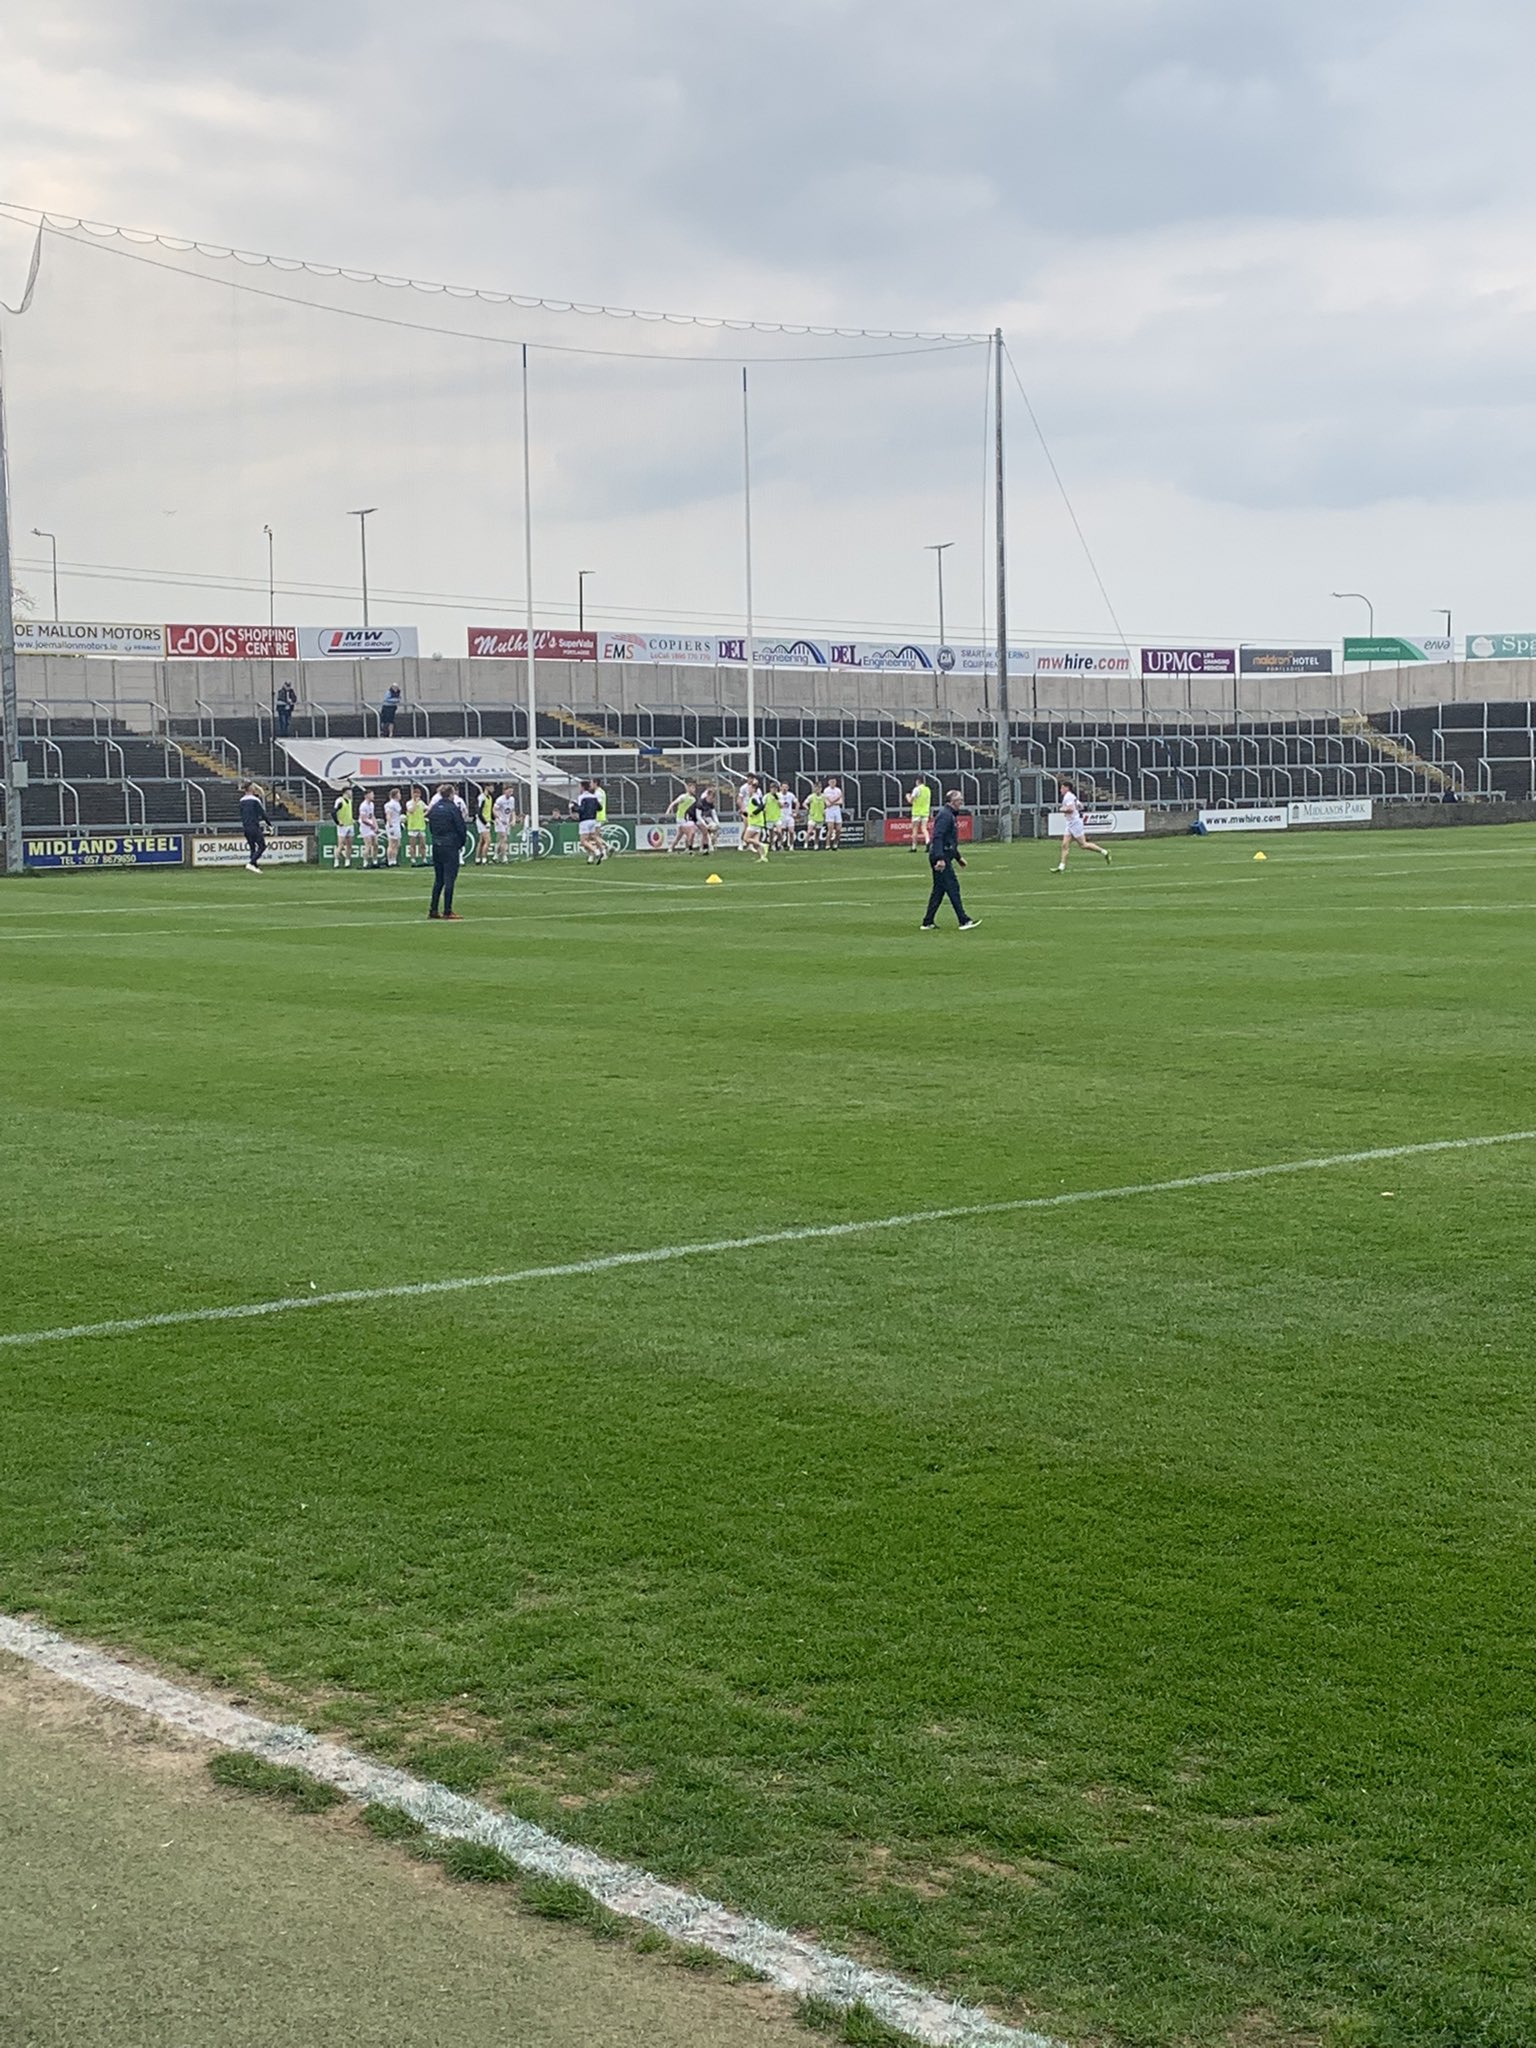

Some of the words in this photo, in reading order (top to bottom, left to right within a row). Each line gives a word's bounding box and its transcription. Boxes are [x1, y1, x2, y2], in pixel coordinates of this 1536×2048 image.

[14, 624, 33, 637] OE
[38, 625, 98, 638] MALLON
[102, 627, 161, 641] MOTORS
[237, 628, 295, 642] SHOPPING
[345, 631, 384, 641] MW
[14, 640, 118, 652] ww.joemallonmotors.ie
[604, 643, 635, 659] EMS
[649, 638, 711, 652] COPIERS
[718, 639, 748, 661] DEL
[1423, 639, 1451, 650] enva
[752, 651, 809, 665] Engineering
[831, 645, 862, 666] DEL
[994, 650, 1030, 659] CERING
[1037, 653, 1130, 670] mwhire.com
[1147, 651, 1202, 671] UPMC
[1292, 656, 1320, 665] HOTEL
[862, 655, 916, 670] Engineering
[962, 659, 1000, 668] EQUIPMEN
[391, 755, 483, 769] MW
[1303, 803, 1344, 816] MIDLANDS
[1345, 801, 1366, 814] PARK
[1206, 813, 1281, 824] www.mwhire.com
[28, 839, 119, 856] MIDLAND
[123, 837, 179, 853] STEEL
[197, 842, 216, 853] JOE
[218, 841, 251, 852] MALLO
[323, 844, 386, 858] EIGRD
[487, 842, 545, 855] EGRID
[563, 840, 621, 853] EIRD
[60, 856, 76, 865] TEL
[84, 855, 100, 864] 057
